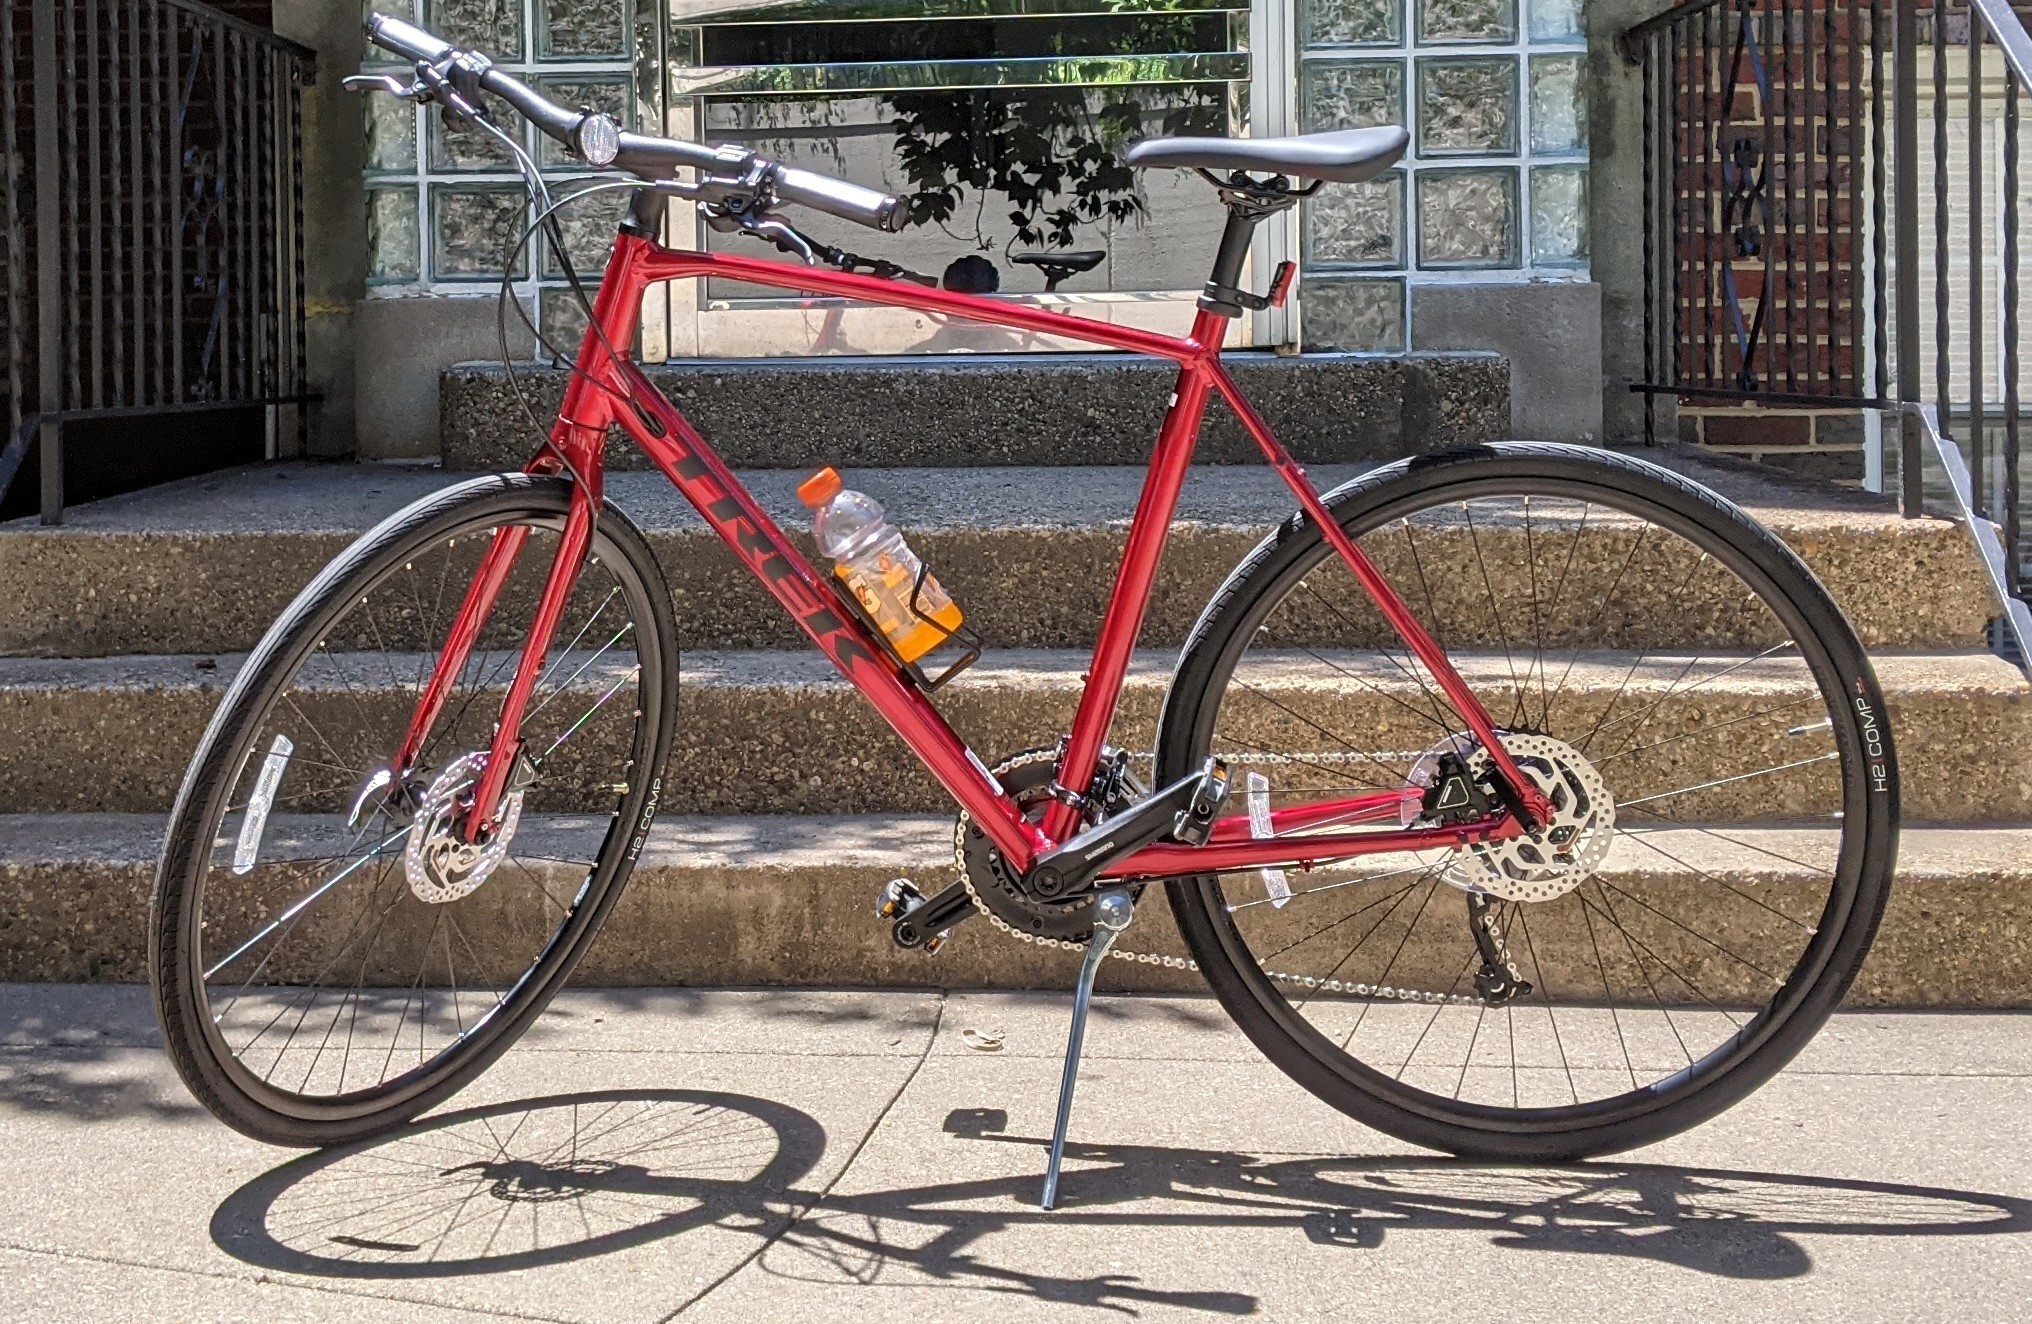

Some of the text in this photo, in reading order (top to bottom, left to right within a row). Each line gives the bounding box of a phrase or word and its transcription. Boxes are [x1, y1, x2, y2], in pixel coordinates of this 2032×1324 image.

[671, 434, 878, 674] TREK
[1856, 697, 1883, 757] COMP
[1872, 764, 1888, 792] H2
[628, 778, 661, 860] H2 COMP
